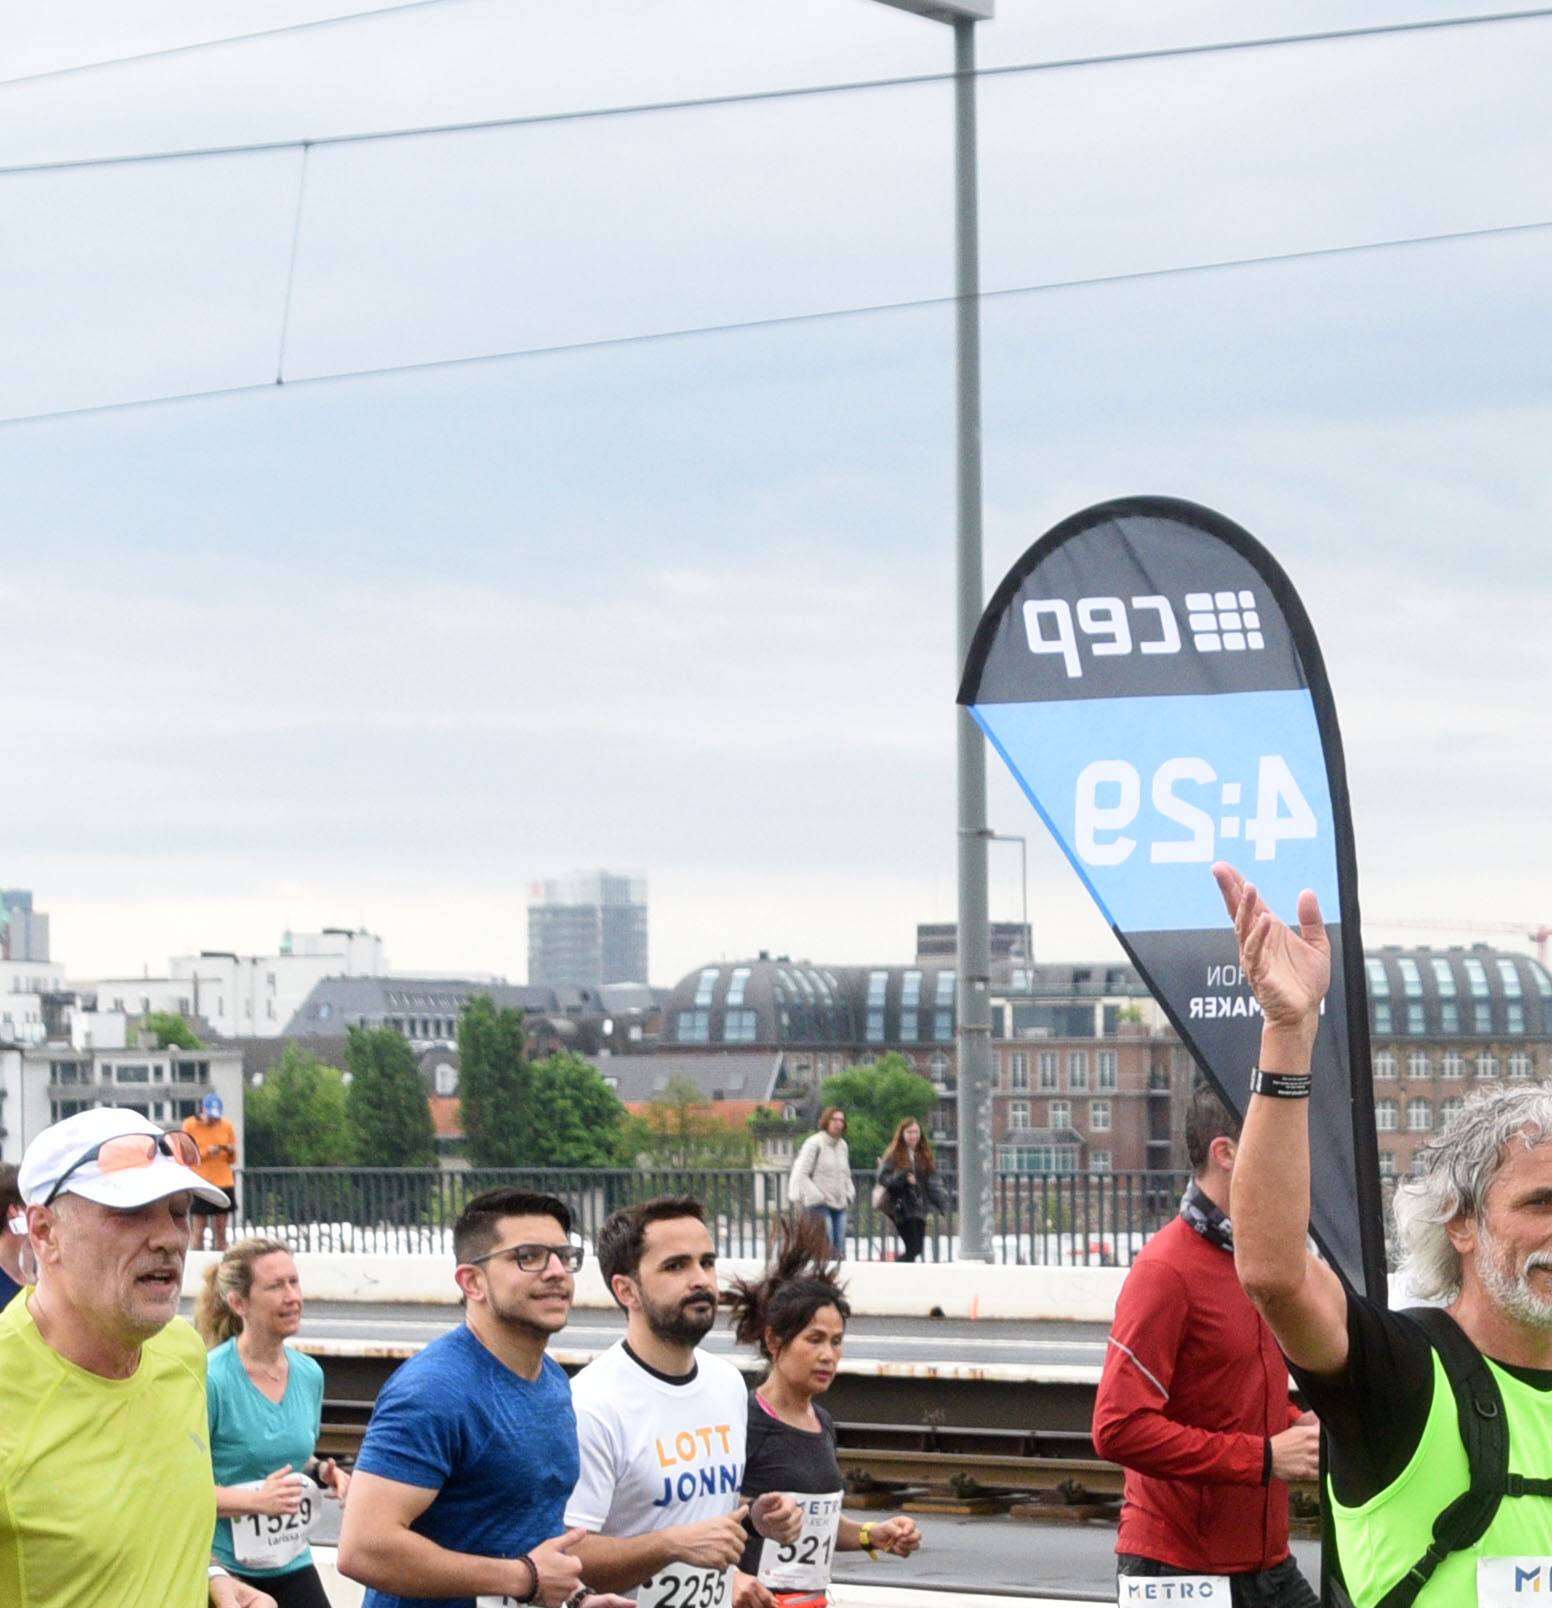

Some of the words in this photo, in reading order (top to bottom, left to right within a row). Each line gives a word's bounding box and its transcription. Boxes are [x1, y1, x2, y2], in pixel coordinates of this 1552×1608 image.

[656, 1424, 731, 1468] LOTT
[777, 1534, 832, 1566] 521
[1128, 1582, 1214, 1600] METRO
